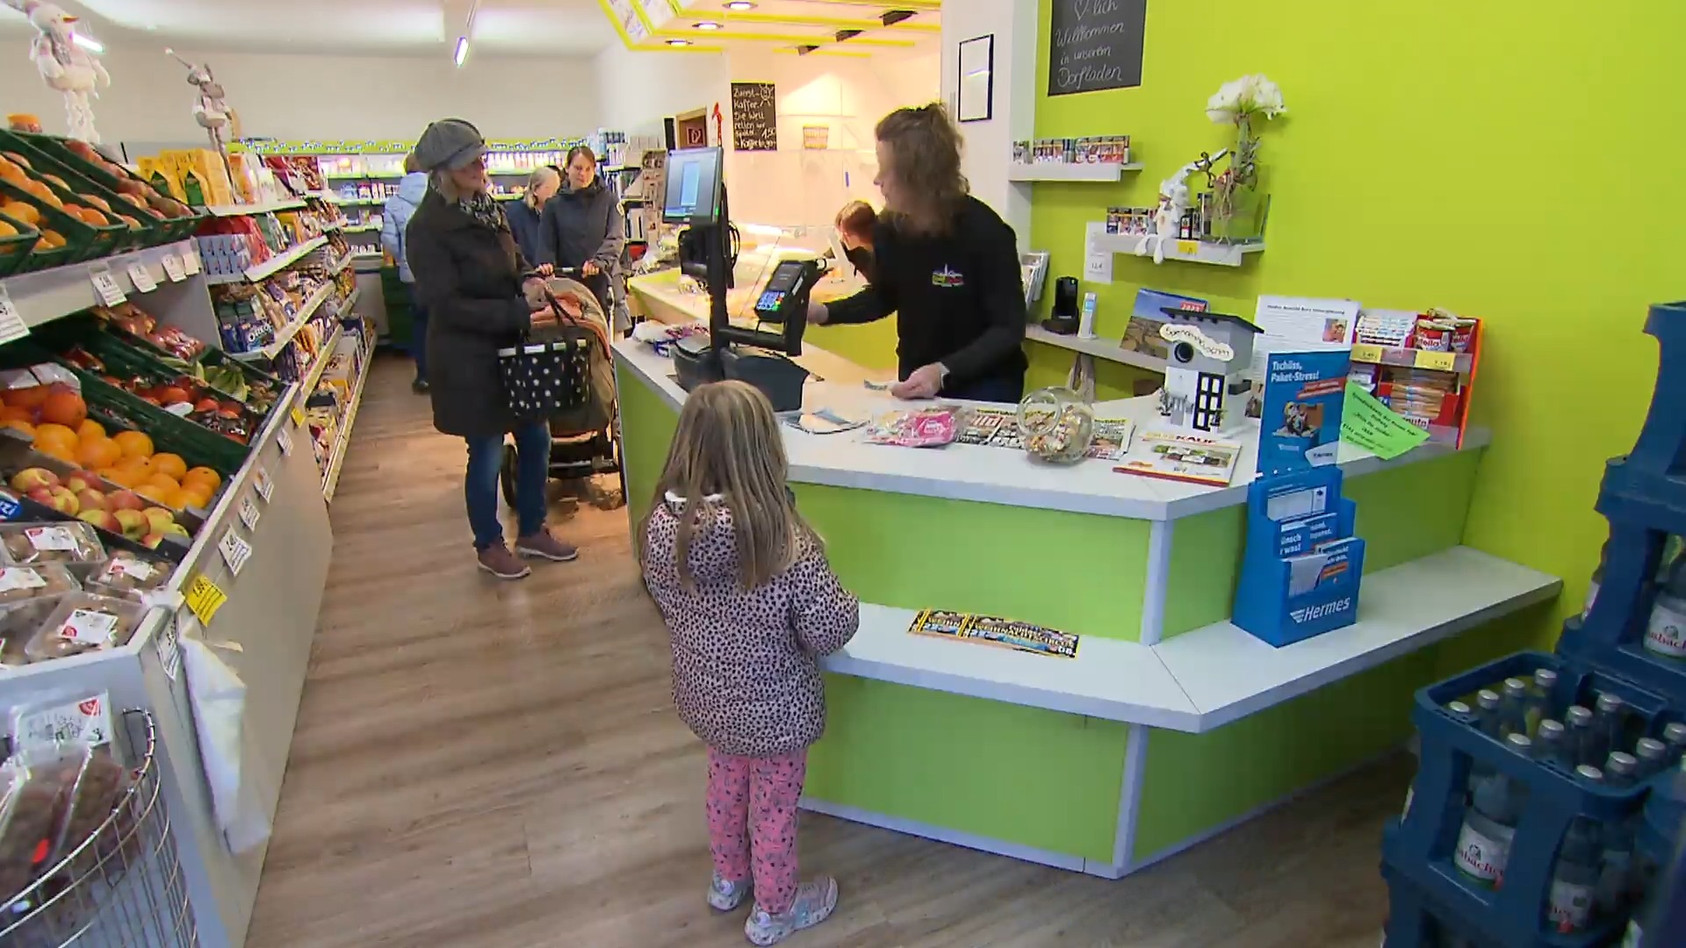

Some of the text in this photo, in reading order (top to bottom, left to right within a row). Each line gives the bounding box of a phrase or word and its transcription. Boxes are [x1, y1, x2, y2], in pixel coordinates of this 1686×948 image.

[1056, 22, 1125, 47] Willkommen
[1060, 45, 1112, 66] in unserem
[1057, 64, 1123, 90] Dorfladen
[1303, 596, 1351, 622] Hermes
